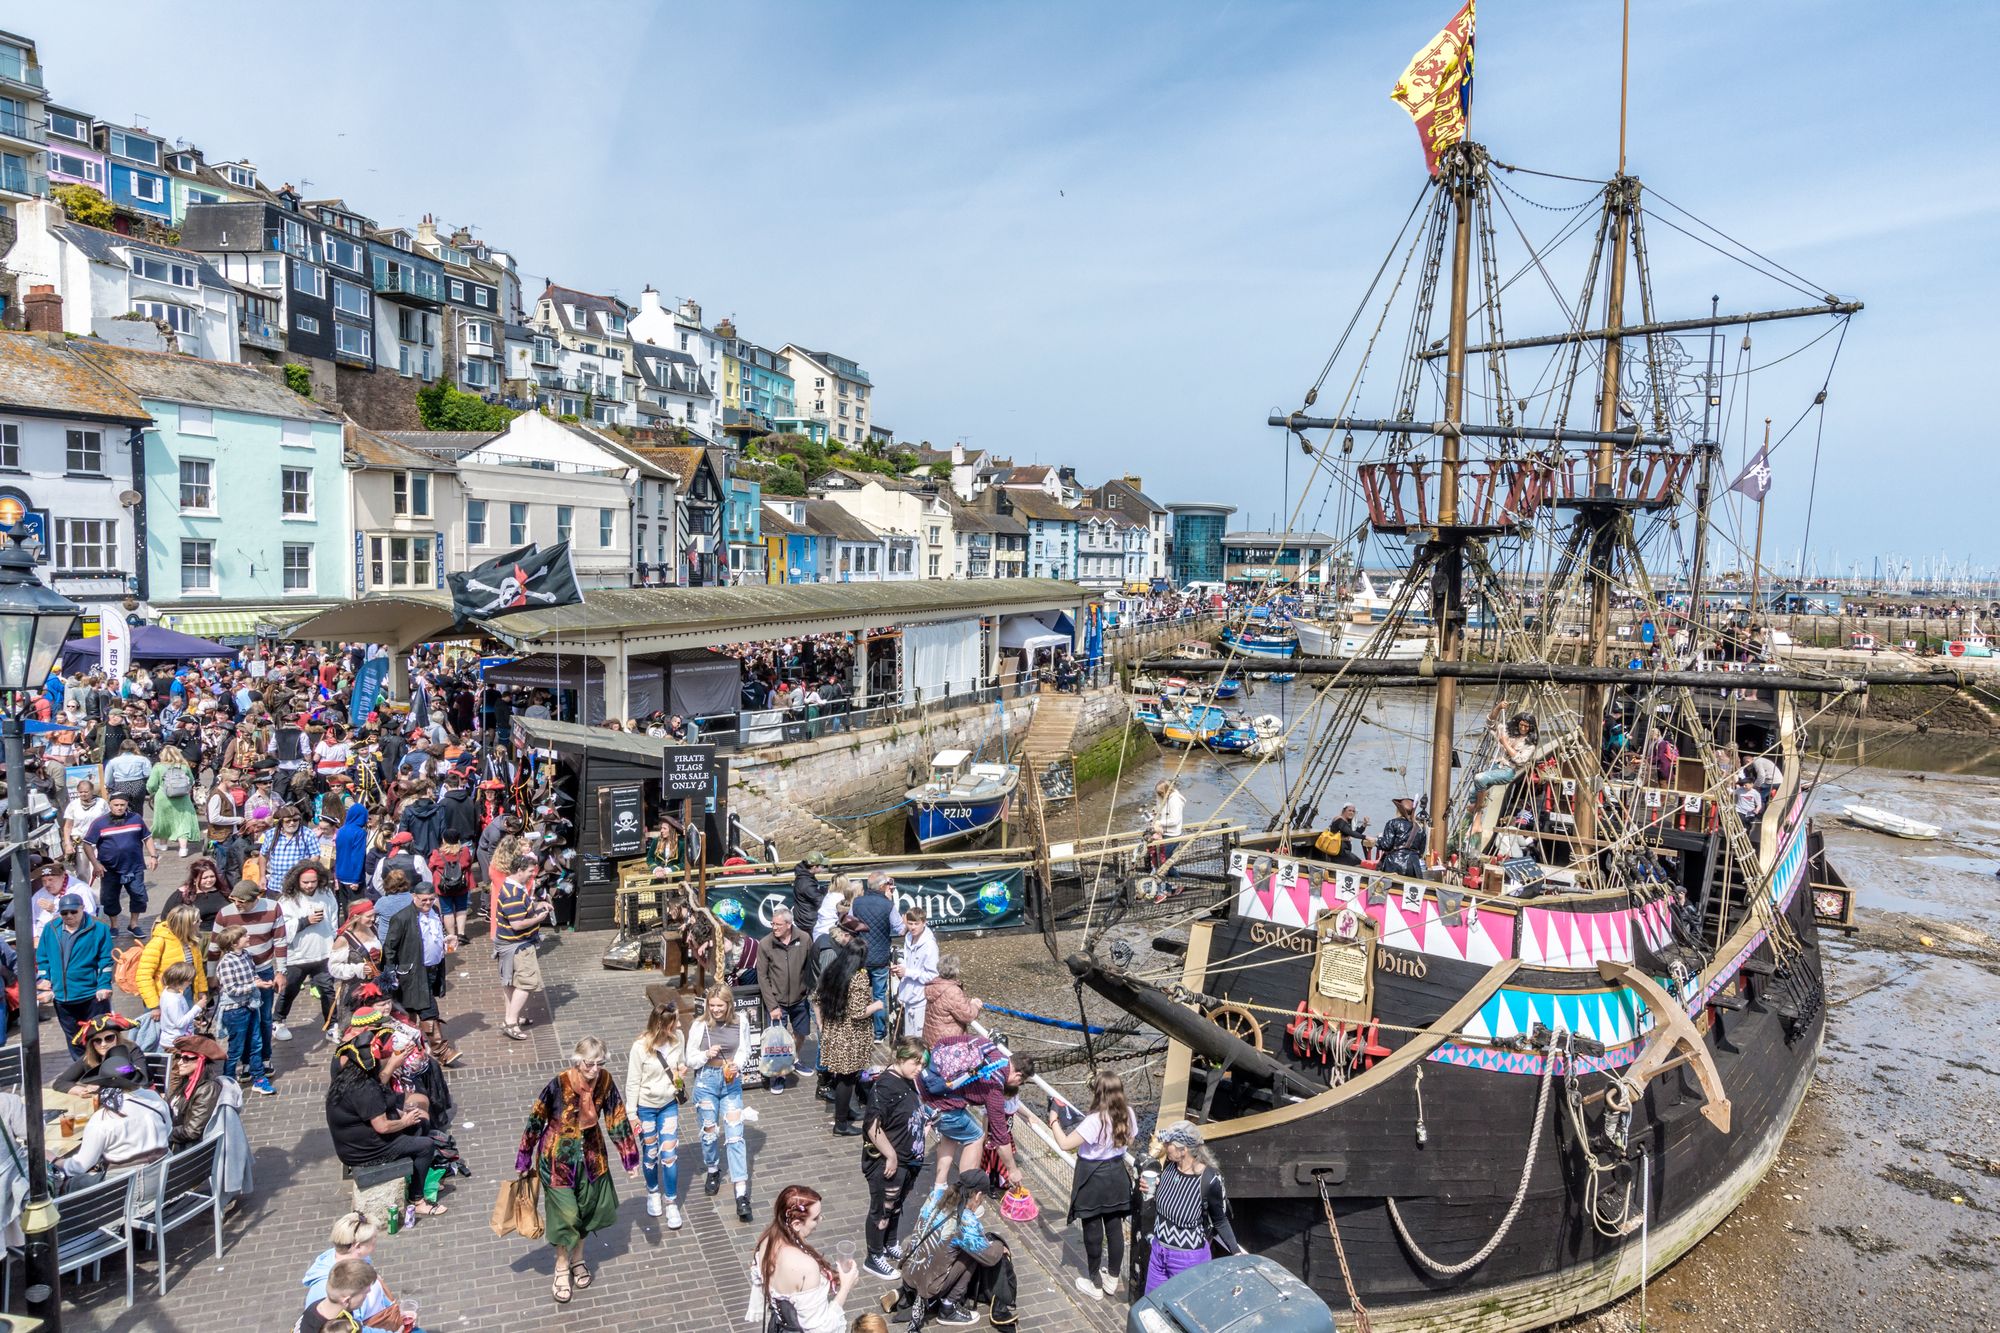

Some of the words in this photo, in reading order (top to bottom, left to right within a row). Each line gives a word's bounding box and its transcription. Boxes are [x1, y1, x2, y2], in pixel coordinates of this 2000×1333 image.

[356, 532, 364, 589] FISHING
[110, 648, 118, 666] RED
[689, 772, 709, 780] SALE
[671, 782, 697, 790] ONLY
[943, 807, 972, 818] PZ130
[1250, 922, 1312, 954] Golden
